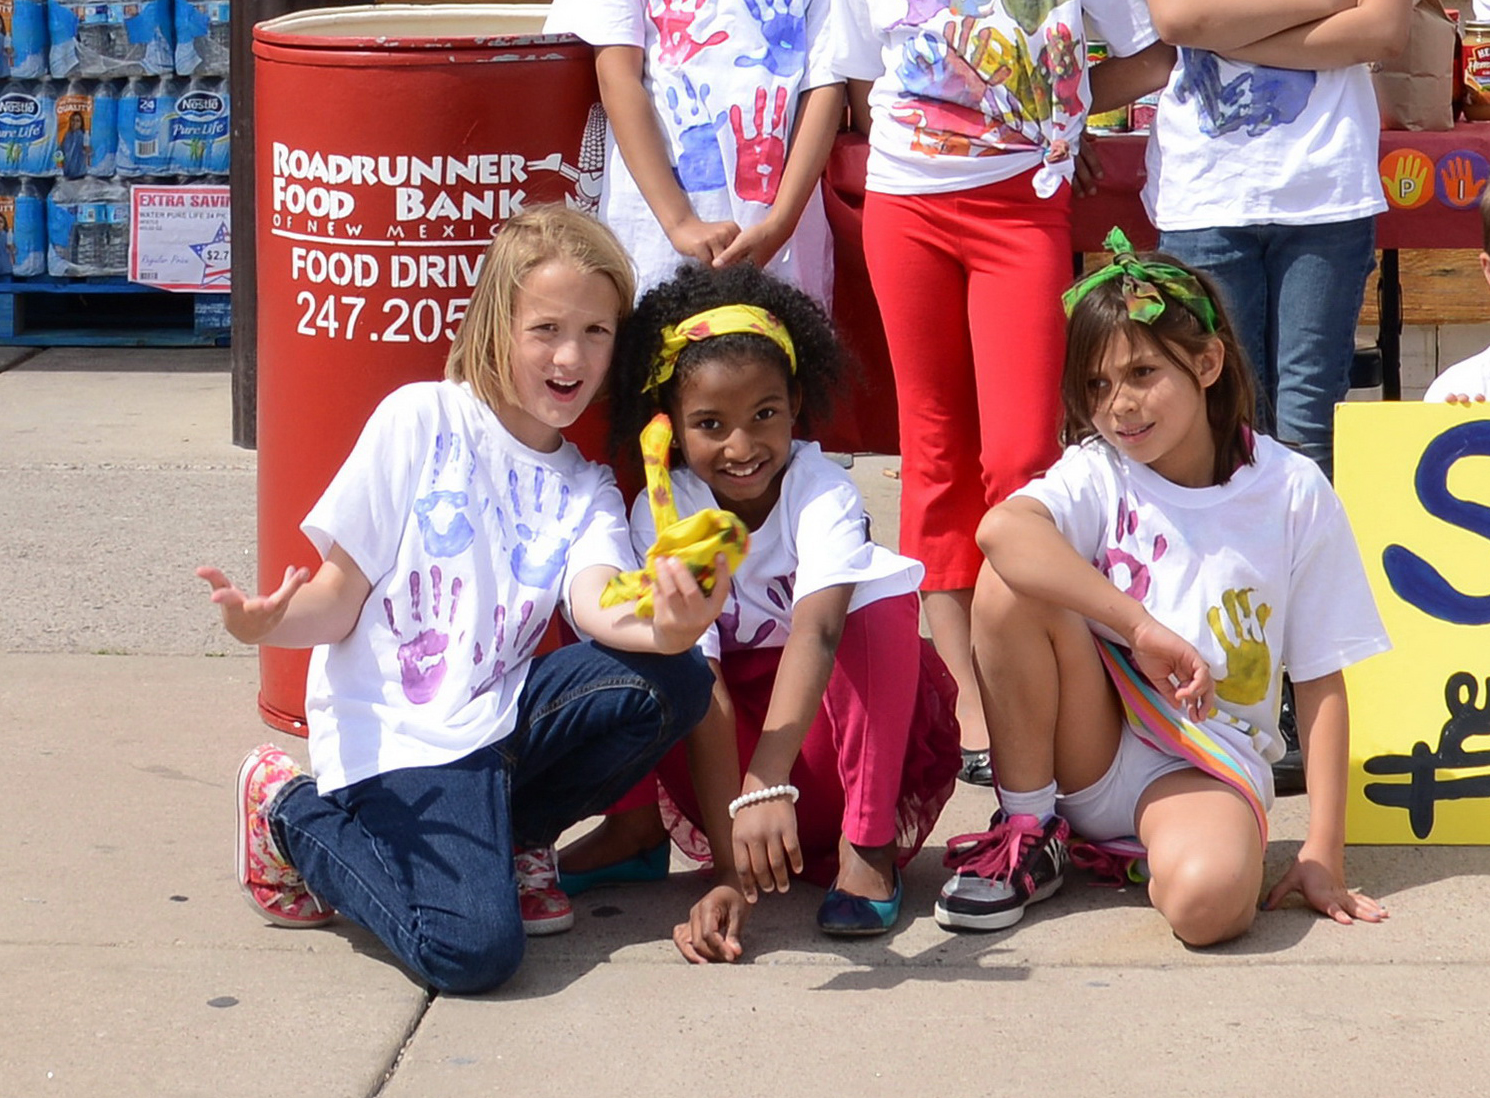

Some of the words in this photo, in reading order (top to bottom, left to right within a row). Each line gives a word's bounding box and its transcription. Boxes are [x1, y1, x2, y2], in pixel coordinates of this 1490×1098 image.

[56, 104, 92, 114] QUALITY
[140, 99, 155, 110] 24
[17, 123, 40, 138] Life
[173, 123, 202, 137] Pure
[202, 120, 225, 135] Life
[272, 141, 528, 187] ROADRUNNER
[139, 194, 186, 208] EXTRA
[272, 176, 355, 221] FOOD
[395, 186, 527, 222] BANK
[272, 213, 292, 229] OF
[307, 217, 363, 238] NEW
[386, 224, 501, 238] MEXIC
[206, 250, 230, 261] $2.7
[291, 247, 379, 288] FOOD
[390, 254, 486, 289] DRIV
[296, 290, 471, 344] 247.205
